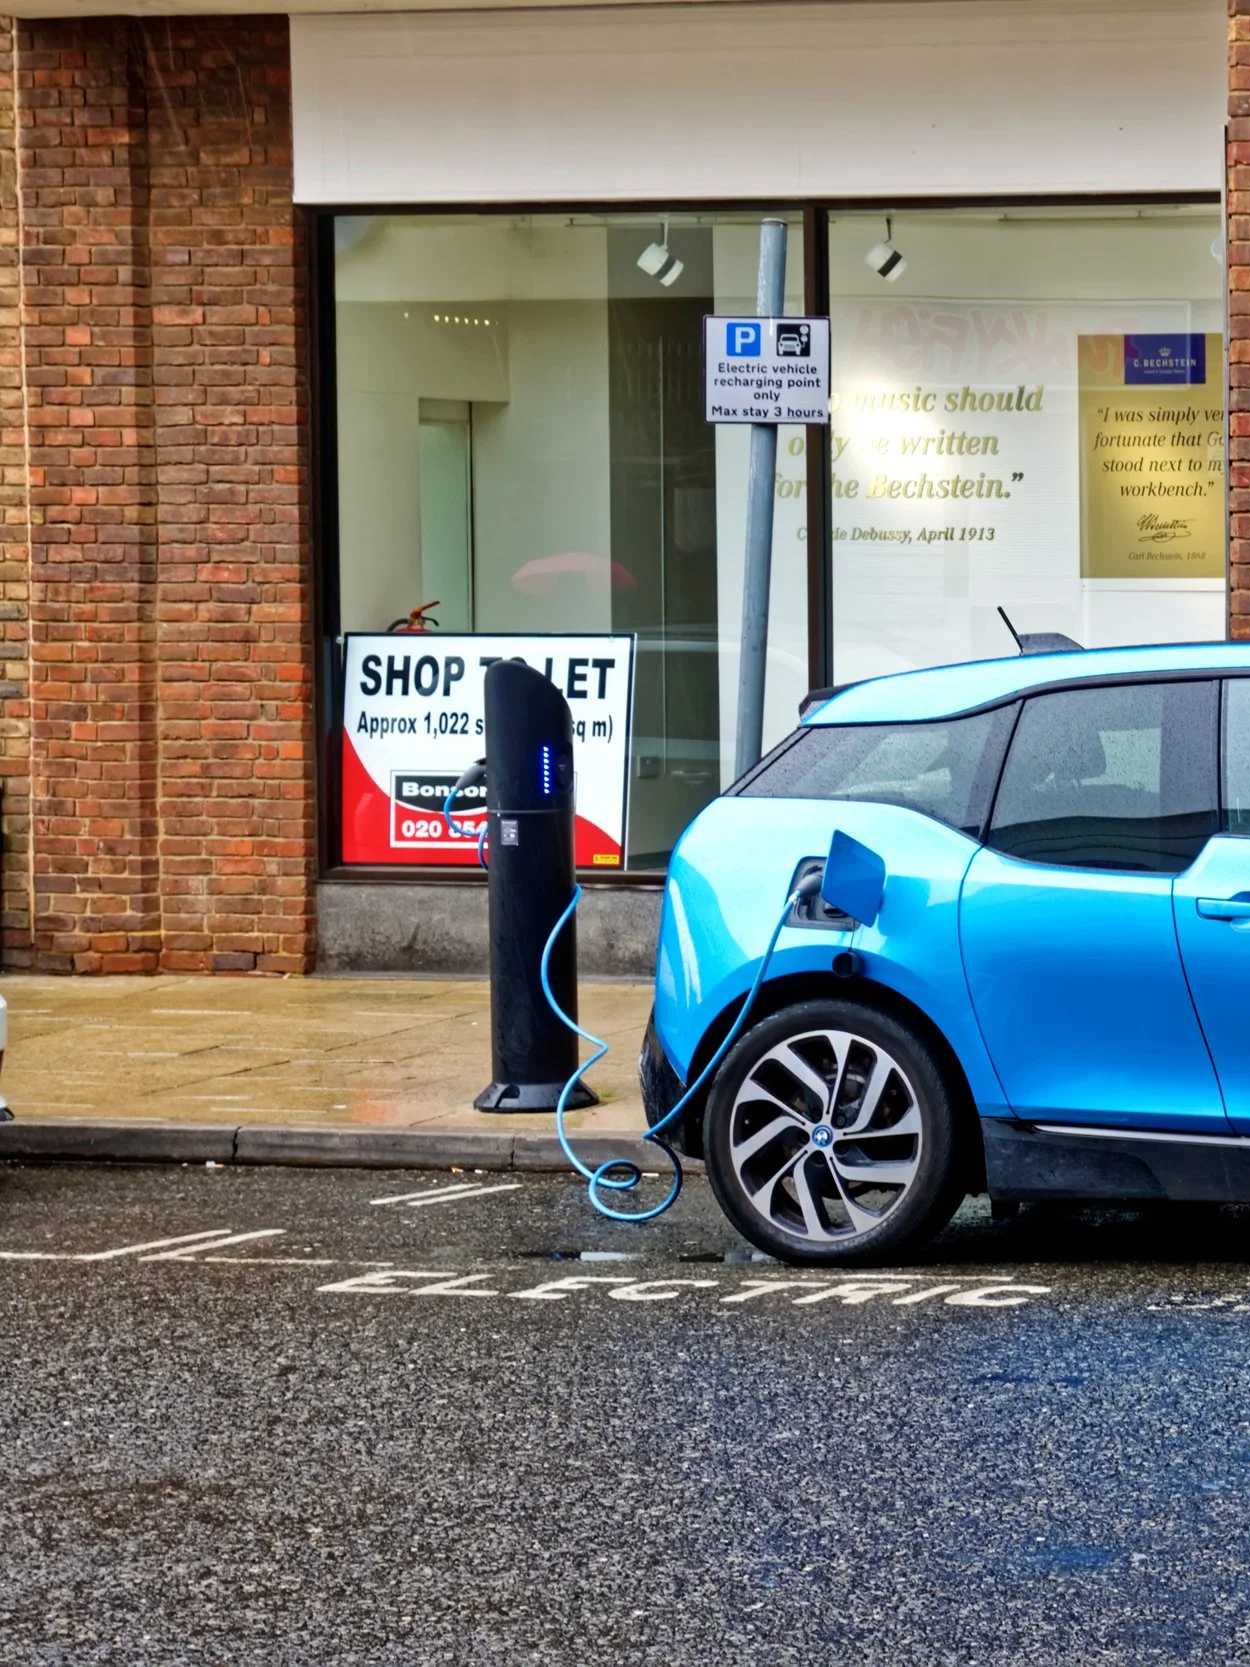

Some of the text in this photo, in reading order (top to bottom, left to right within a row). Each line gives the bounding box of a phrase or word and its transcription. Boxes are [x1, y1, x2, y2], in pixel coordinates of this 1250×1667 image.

[735, 327, 756, 354] P
[718, 363, 818, 375] Electric vehicle
[1144, 358, 1197, 367] BECHSTEIN
[714, 376, 821, 389] recharging point
[753, 390, 781, 402] only
[943, 385, 1044, 413] should
[711, 406, 824, 418] Max stay 3 hours
[1114, 409, 1144, 423] was
[1148, 406, 1200, 427] simply
[1204, 409, 1224, 422] ver
[900, 428, 1000, 456] written
[1093, 430, 1224, 452] fortunate that Go
[1102, 456, 1143, 473] stood
[1149, 457, 1182, 473] next
[1188, 458, 1203, 473] to
[865, 471, 1024, 500] Bechstein.”
[1120, 480, 1214, 497] workbench.”
[850, 526, 912, 544] Debussy,
[916, 526, 954, 544] April
[959, 526, 995, 541] 1913
[1128, 551, 1145, 561] Carl
[360, 655, 465, 697] SHOP
[356, 711, 417, 739] Approx
[423, 712, 469, 739] 1,022
[592, 714, 613, 744] m)
[401, 820, 443, 838] 020
[315, 1269, 1051, 1307] ELECTRIC
